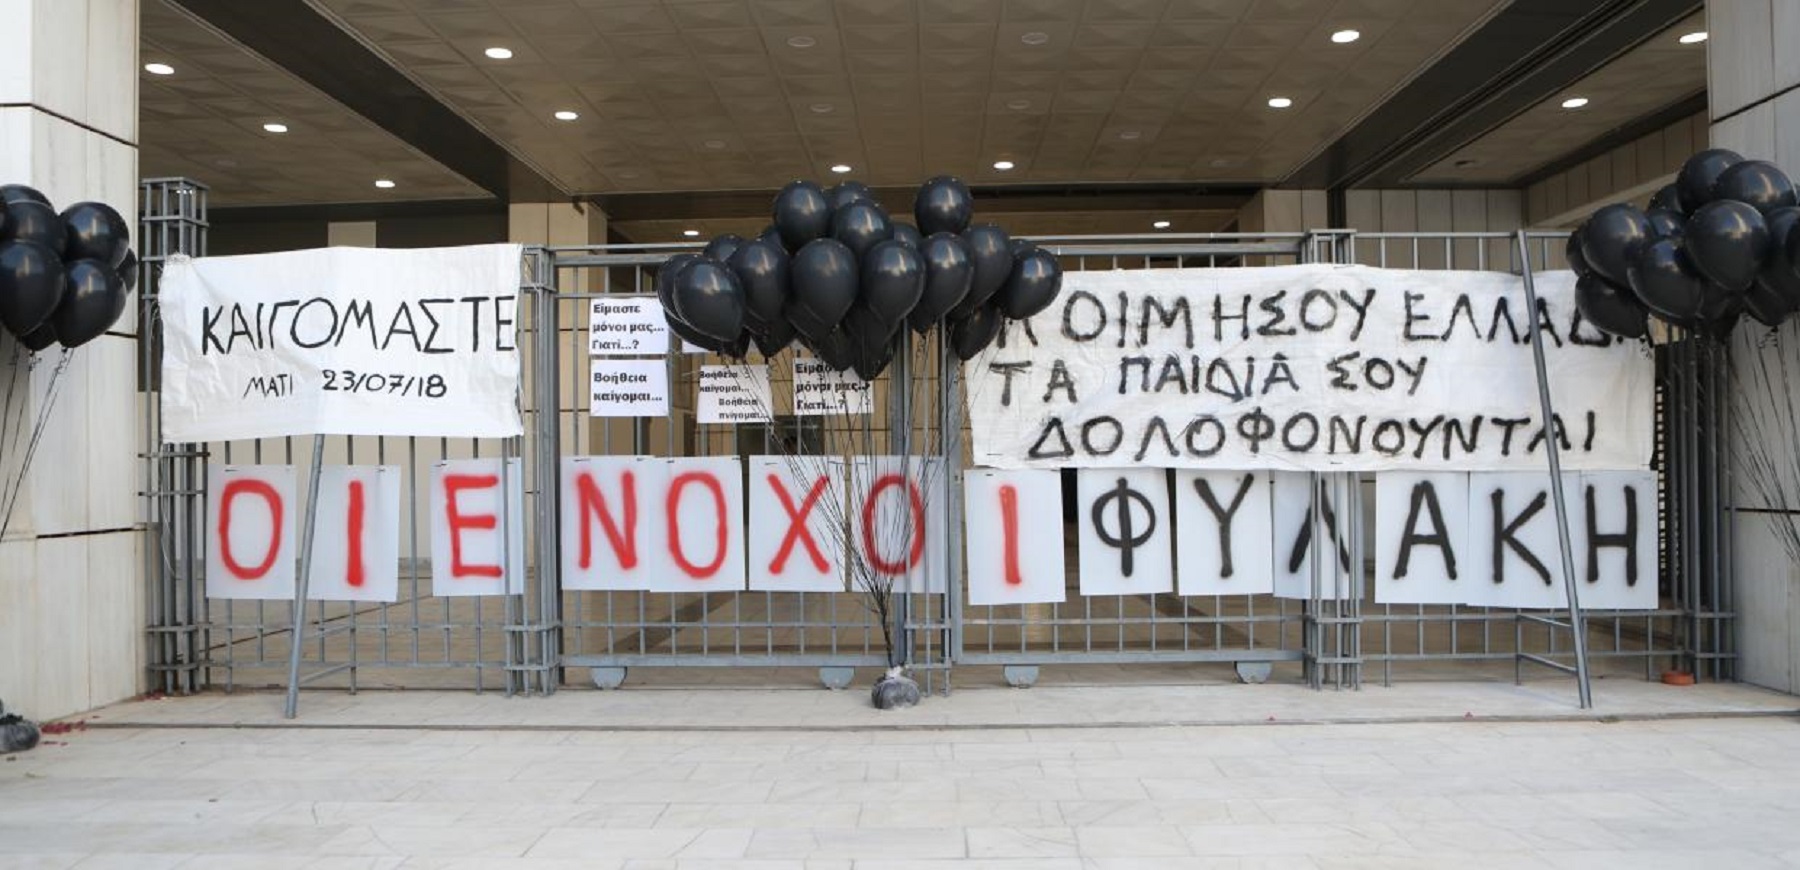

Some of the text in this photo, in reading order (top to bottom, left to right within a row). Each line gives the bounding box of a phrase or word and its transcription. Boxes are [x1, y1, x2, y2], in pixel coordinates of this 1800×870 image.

[201, 295, 517, 355] ΚΑΙΓΟΜΑΣΤΕ
[593, 303, 641, 316] Είμαστε
[593, 321, 664, 334] μόνοι μας...
[1404, 292, 1653, 348] ΕΛΛΑΔ
[243, 369, 448, 398] ΜΑΤΙ 23/07/18
[593, 390, 663, 404] καίγομαι...
[594, 371, 647, 385] Βοήθεια
[989, 350, 1428, 406] ΤΑ ΠΑΙΔΙΑ ΣΟΥ
[1028, 406, 1595, 461] ΔΟΛΟΦΟΝΟΥΝΤΑΙ
[219, 479, 365, 587] ΟΙ
[1091, 473, 1638, 587] ΦΥΛΑΚΗ
